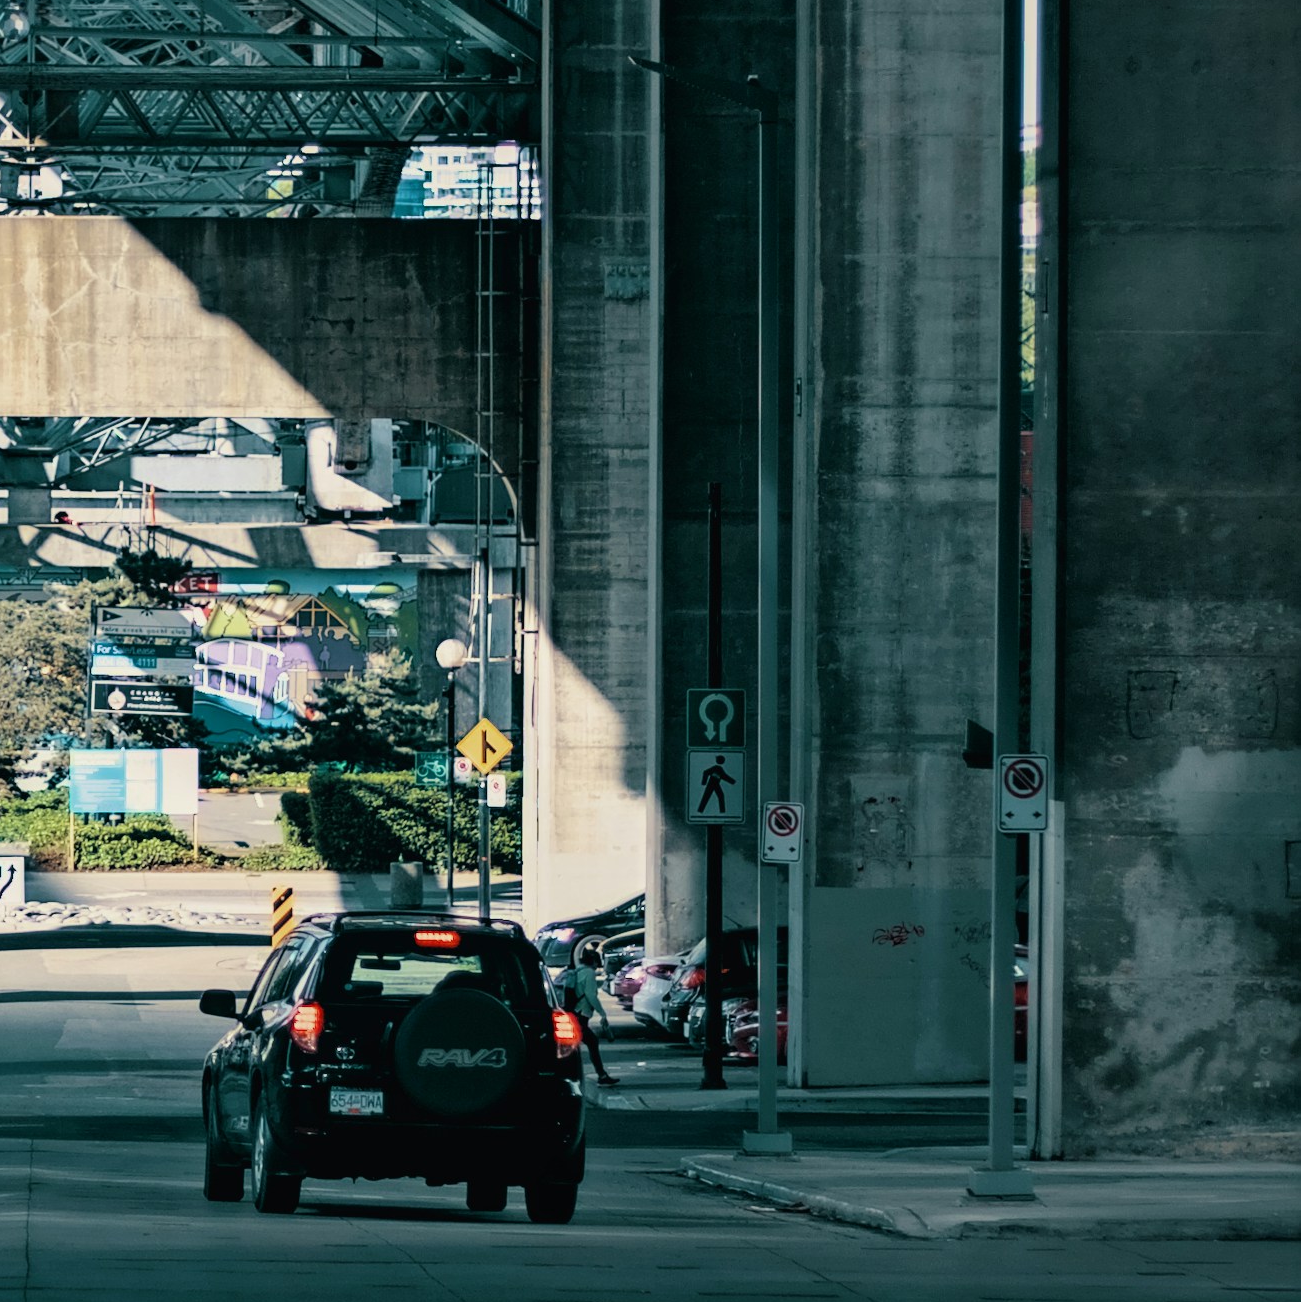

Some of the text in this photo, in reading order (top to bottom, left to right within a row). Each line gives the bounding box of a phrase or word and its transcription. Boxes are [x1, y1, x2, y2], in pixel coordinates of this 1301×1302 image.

[173, 576, 213, 593] KET
[96, 644, 110, 654] For
[417, 1047, 507, 1068] RAV4
